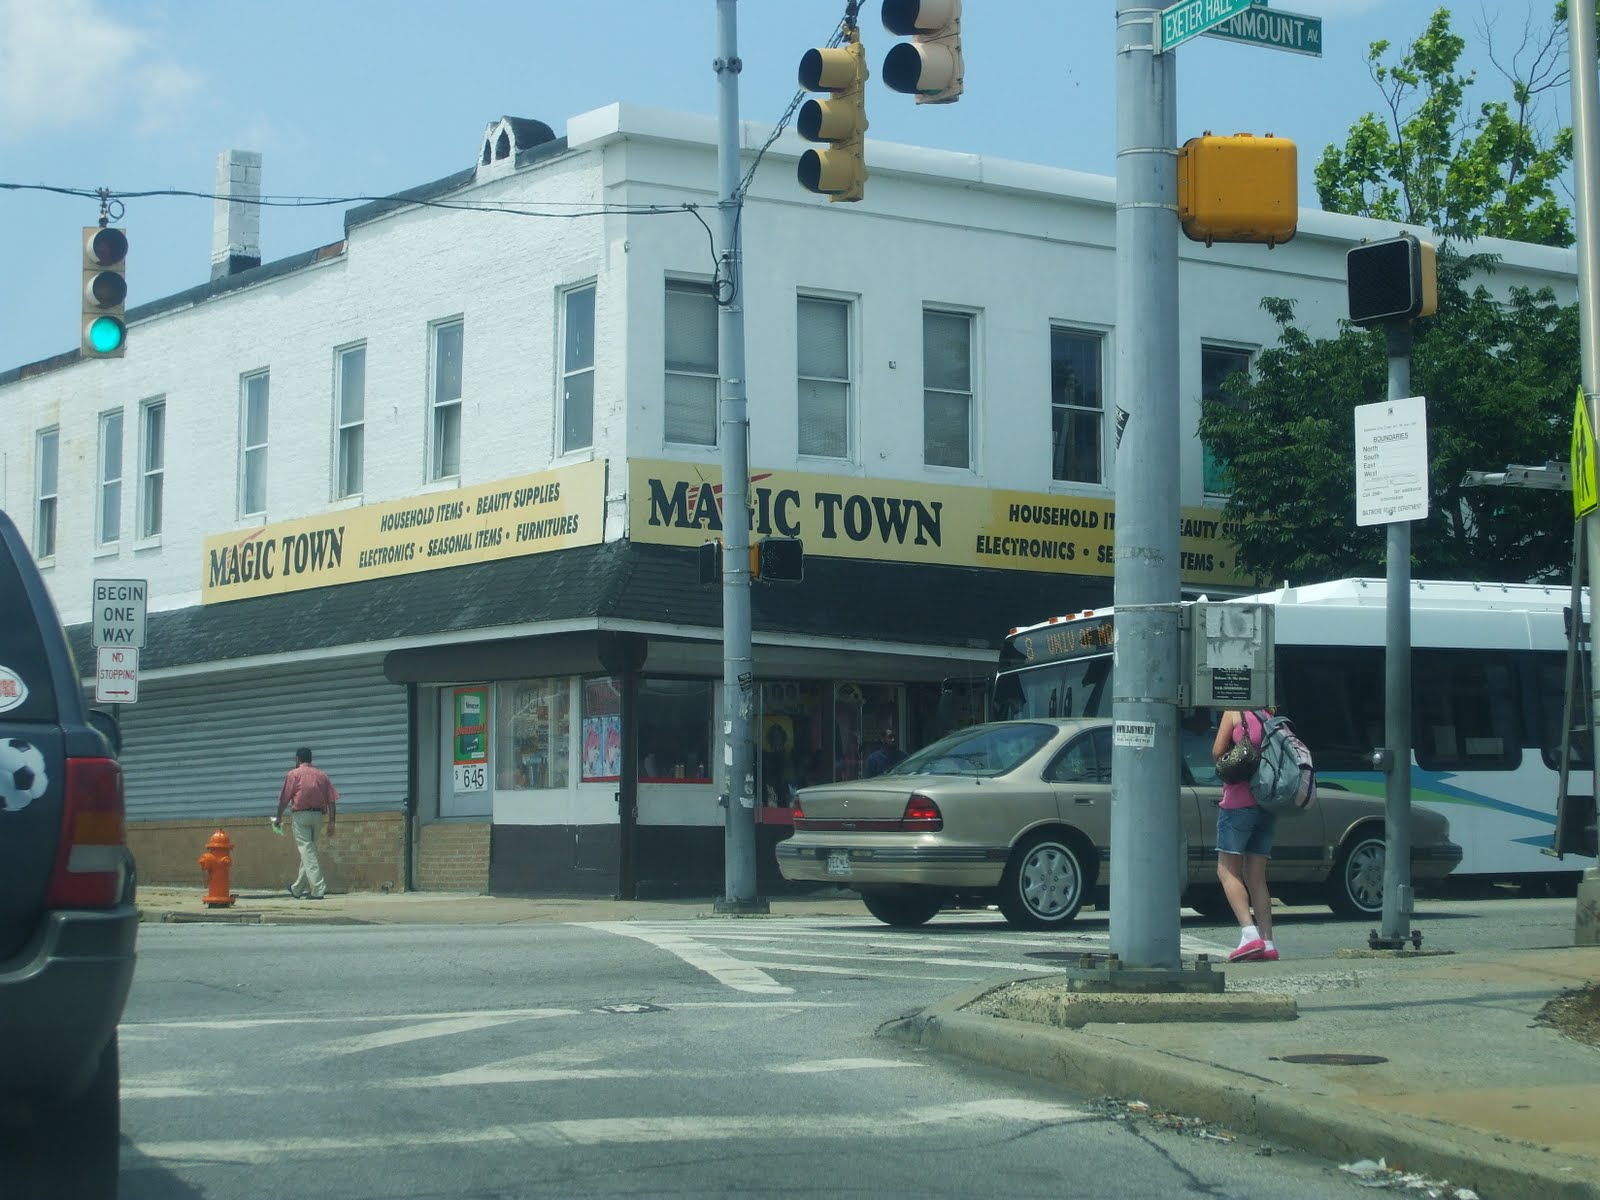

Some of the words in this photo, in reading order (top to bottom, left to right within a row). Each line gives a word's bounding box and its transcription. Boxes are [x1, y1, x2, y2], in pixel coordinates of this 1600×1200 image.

[1165, 1, 1203, 43] EXETER
[1212, 11, 1305, 46] NMOUNT
[1373, 432, 1409, 442] BOUNDARIES
[380, 506, 434, 533] HOUSEHOLD
[436, 500, 464, 524] ITEMS
[476, 493, 512, 516] BEAUTY
[513, 482, 561, 508] SUPPLIES
[648, 478, 801, 536] MAIC
[815, 492, 943, 548] TOWN
[1009, 503, 1099, 529] HOUSEHOLD
[1180, 518, 1219, 539] EAUTY
[358, 542, 415, 569] ELECTRONICS
[427, 532, 472, 557] SEASONAL
[474, 526, 503, 547] ITEMS
[516, 513, 579, 543] FURNITURES
[976, 535, 1075, 561] ELECTRONICS
[208, 538, 275, 588] MAGIC
[282, 526, 345, 576] TOWN
[1180, 551, 1214, 572] TEMS
[97, 586, 144, 601] BEGIN
[104, 607, 135, 621] ONE
[103, 628, 135, 642] WAY
[112, 652, 124, 663] NO
[100, 669, 135, 681] STOPPING
[455, 770, 459, 780] $
